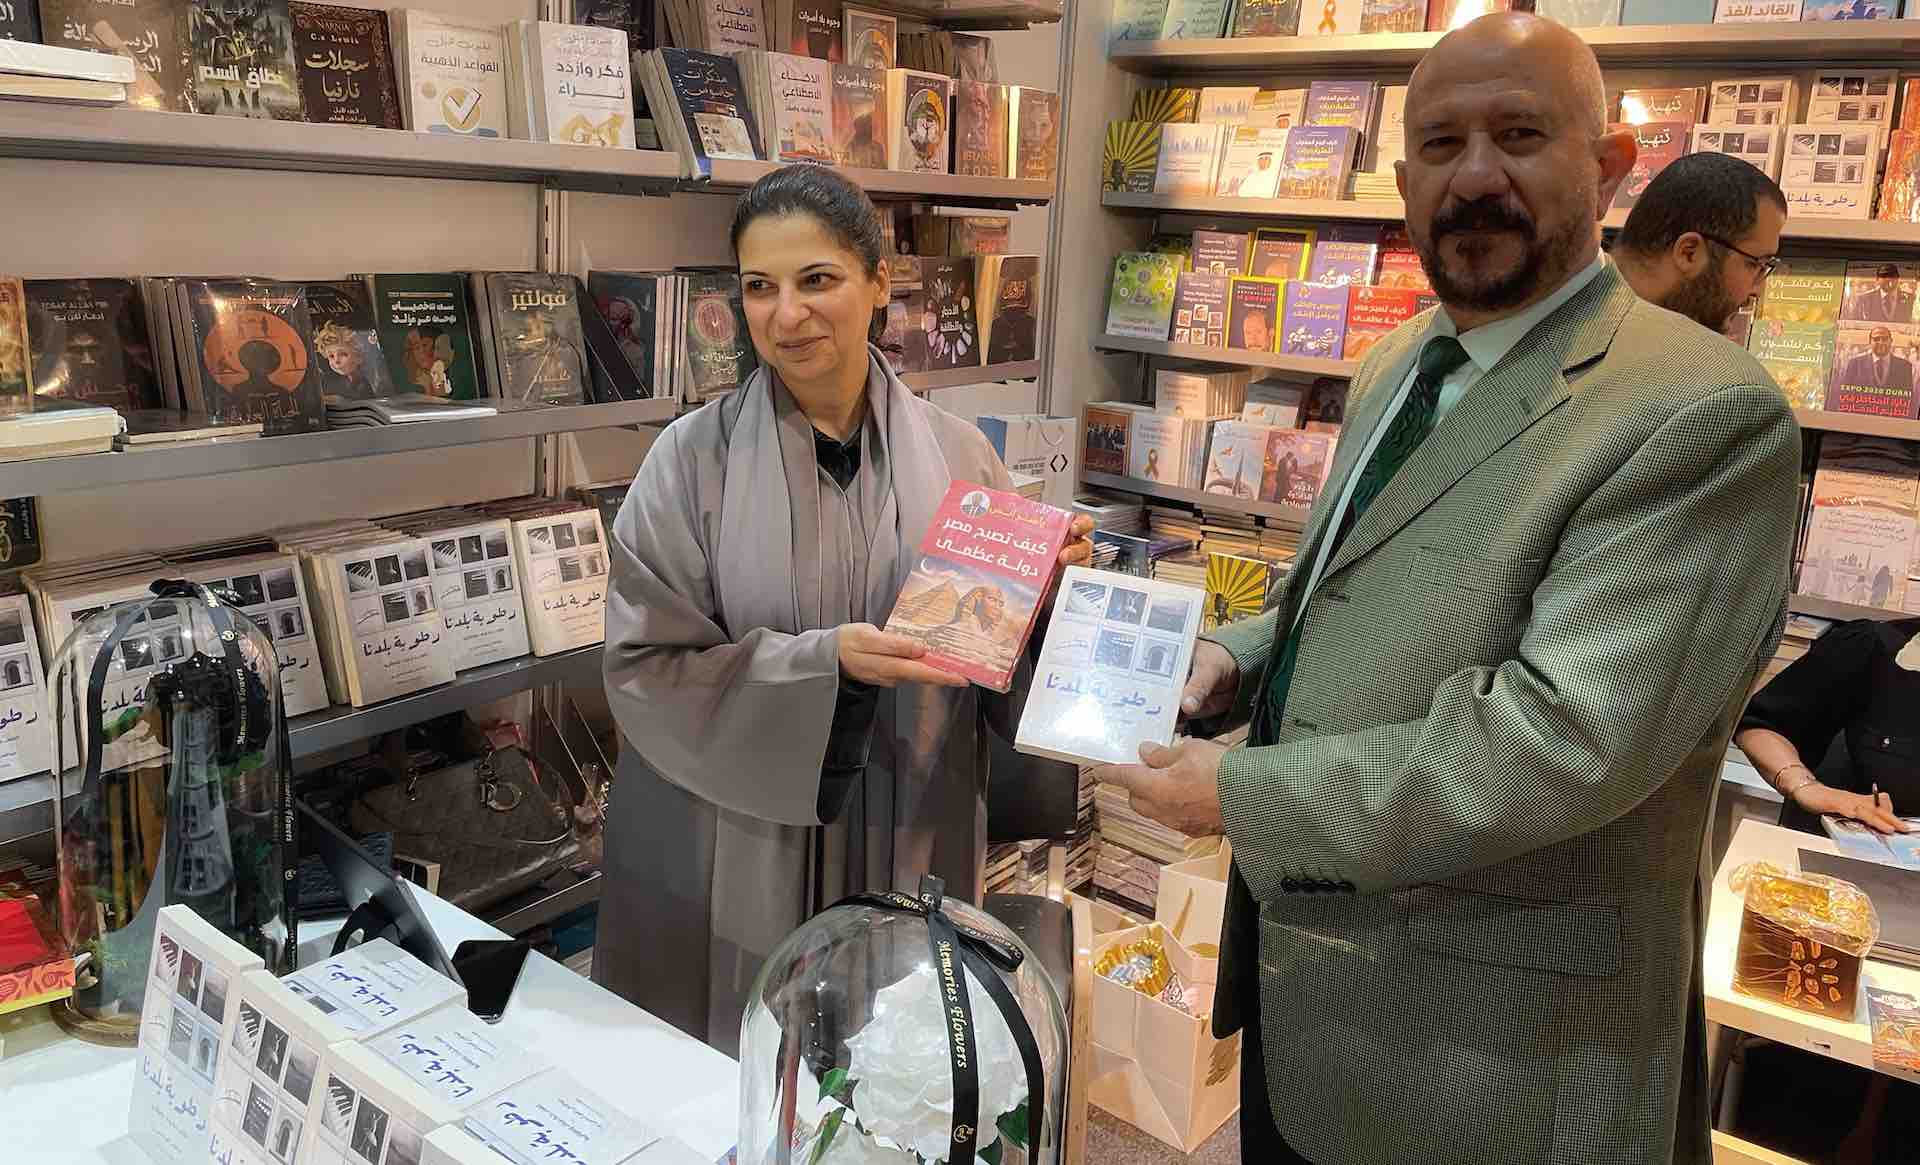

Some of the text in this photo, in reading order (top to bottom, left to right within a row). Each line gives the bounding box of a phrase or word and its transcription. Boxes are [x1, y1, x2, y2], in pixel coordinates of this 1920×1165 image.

[304, 49, 369, 72] سجلات
[511, 289, 567, 311] فولتير
[942, 517, 972, 533] مصر
[974, 527, 1013, 545] تصبح
[1013, 536, 1048, 555] كيف
[936, 537, 1039, 577] دولة عظمى
[444, 607, 516, 629] رطوبة بلدنا
[362, 631, 440, 657] رطوبة بلدنا
[280, 655, 309, 672] رطو
[936, 940, 969, 1069] Memories Flowers
